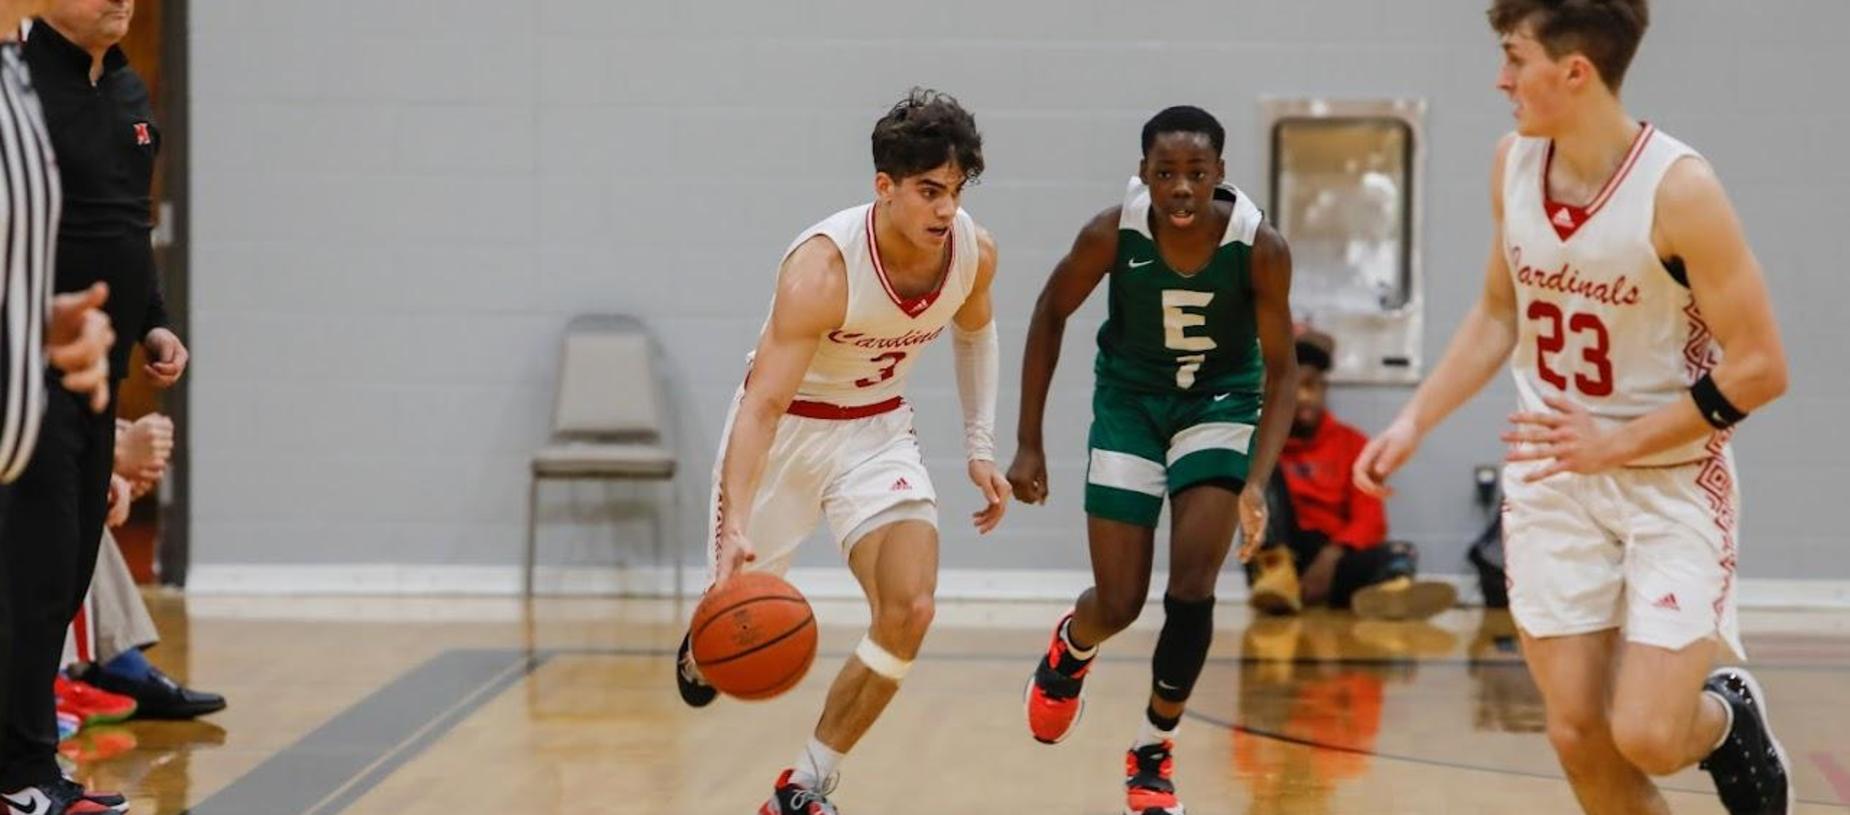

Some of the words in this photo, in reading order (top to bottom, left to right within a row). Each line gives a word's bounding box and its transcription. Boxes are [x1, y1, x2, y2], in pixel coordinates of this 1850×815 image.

[1162, 289, 1218, 351] E
[1527, 300, 1613, 397] 23
[855, 351, 907, 388] 3
